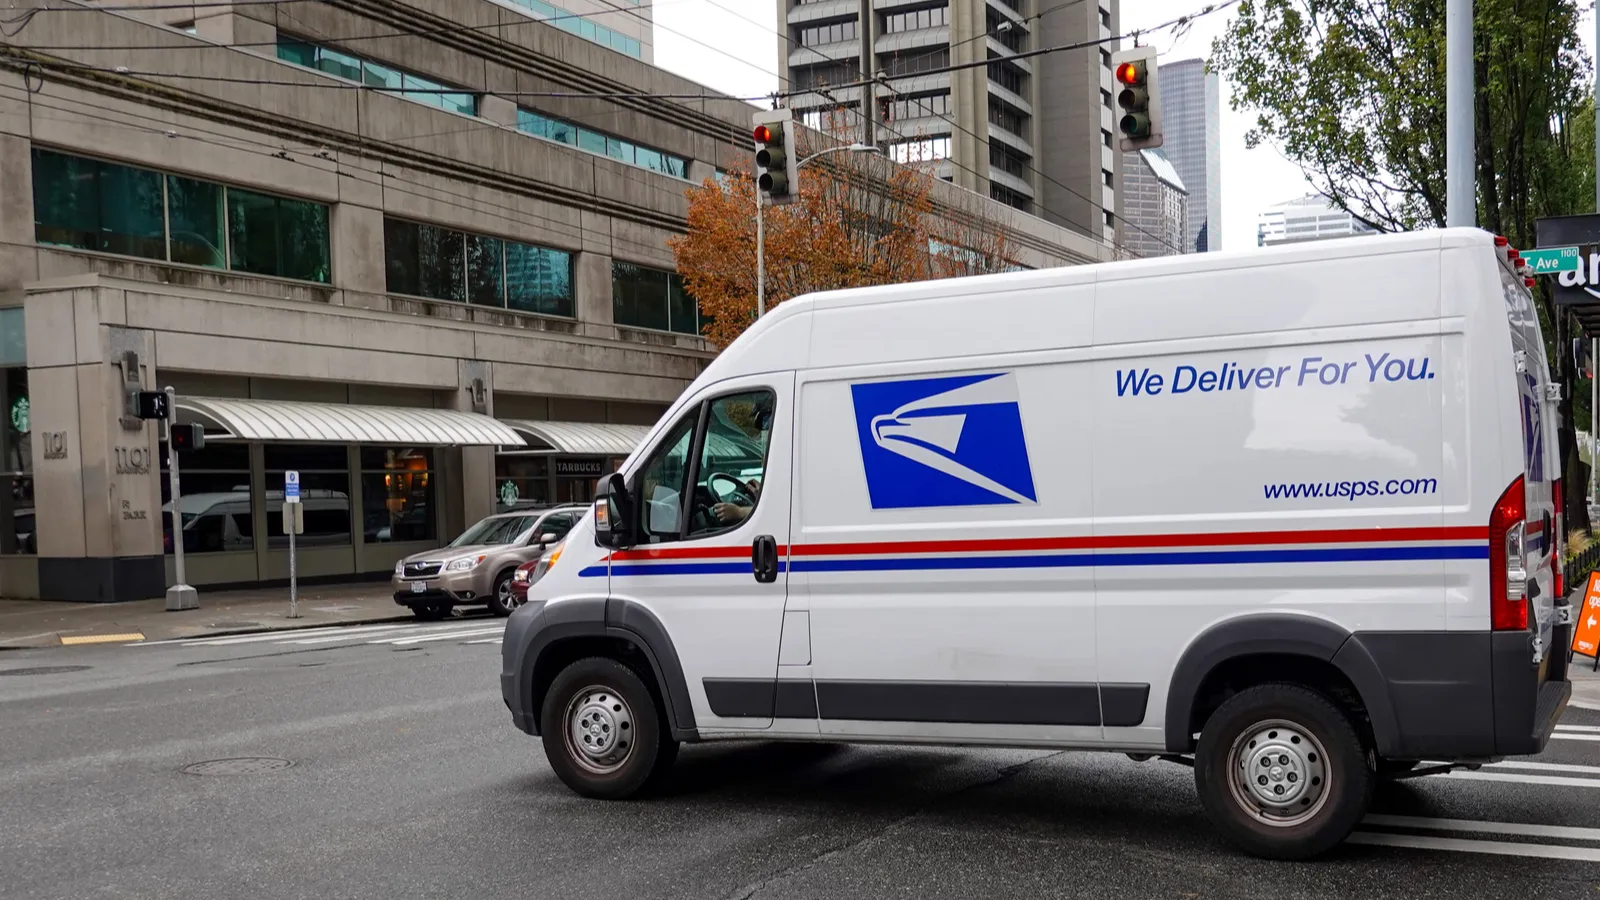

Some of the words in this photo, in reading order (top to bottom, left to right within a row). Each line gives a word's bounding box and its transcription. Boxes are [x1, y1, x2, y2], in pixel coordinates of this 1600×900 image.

[1536, 257, 1558, 269] Ave
[1561, 249, 1577, 257] 1100
[1116, 368, 1163, 397] We
[1171, 362, 1291, 394] Deliver
[1297, 357, 1357, 386] For
[1364, 352, 1435, 383] You.
[42, 431, 67, 453] 1101
[115, 446, 151, 468] 1101
[556, 462, 601, 472] TARBUCKS
[1264, 478, 1437, 501] www.usps.com
